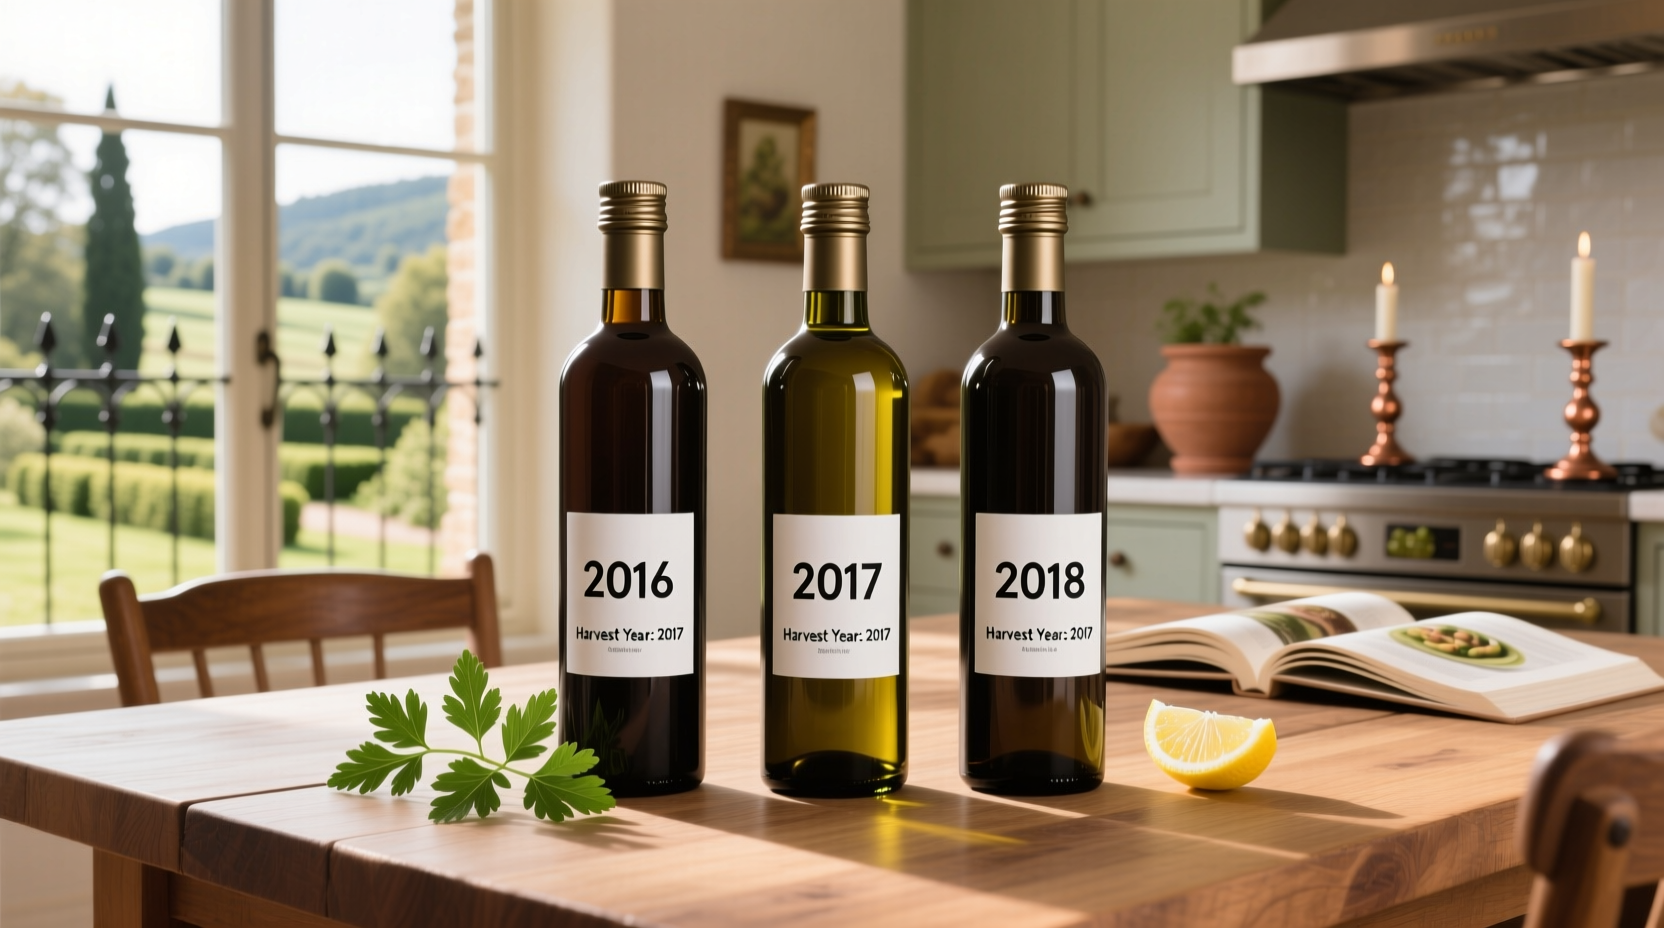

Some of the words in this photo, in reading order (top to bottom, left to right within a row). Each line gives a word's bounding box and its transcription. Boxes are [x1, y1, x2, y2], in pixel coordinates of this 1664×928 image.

[583, 560, 674, 600] 2016
[793, 562, 883, 601] 2017
[995, 561, 1085, 600] 2018
[576, 626, 620, 641] Harvest
[622, 628, 655, 642] Year:
[657, 627, 684, 641] 2017
[783, 628, 828, 642] Harvest
[831, 629, 863, 642] Year:
[866, 628, 891, 642] 2017
[986, 626, 1034, 641] Harvest
[1036, 628, 1068, 641] Year:
[1070, 626, 1093, 640] 2017
